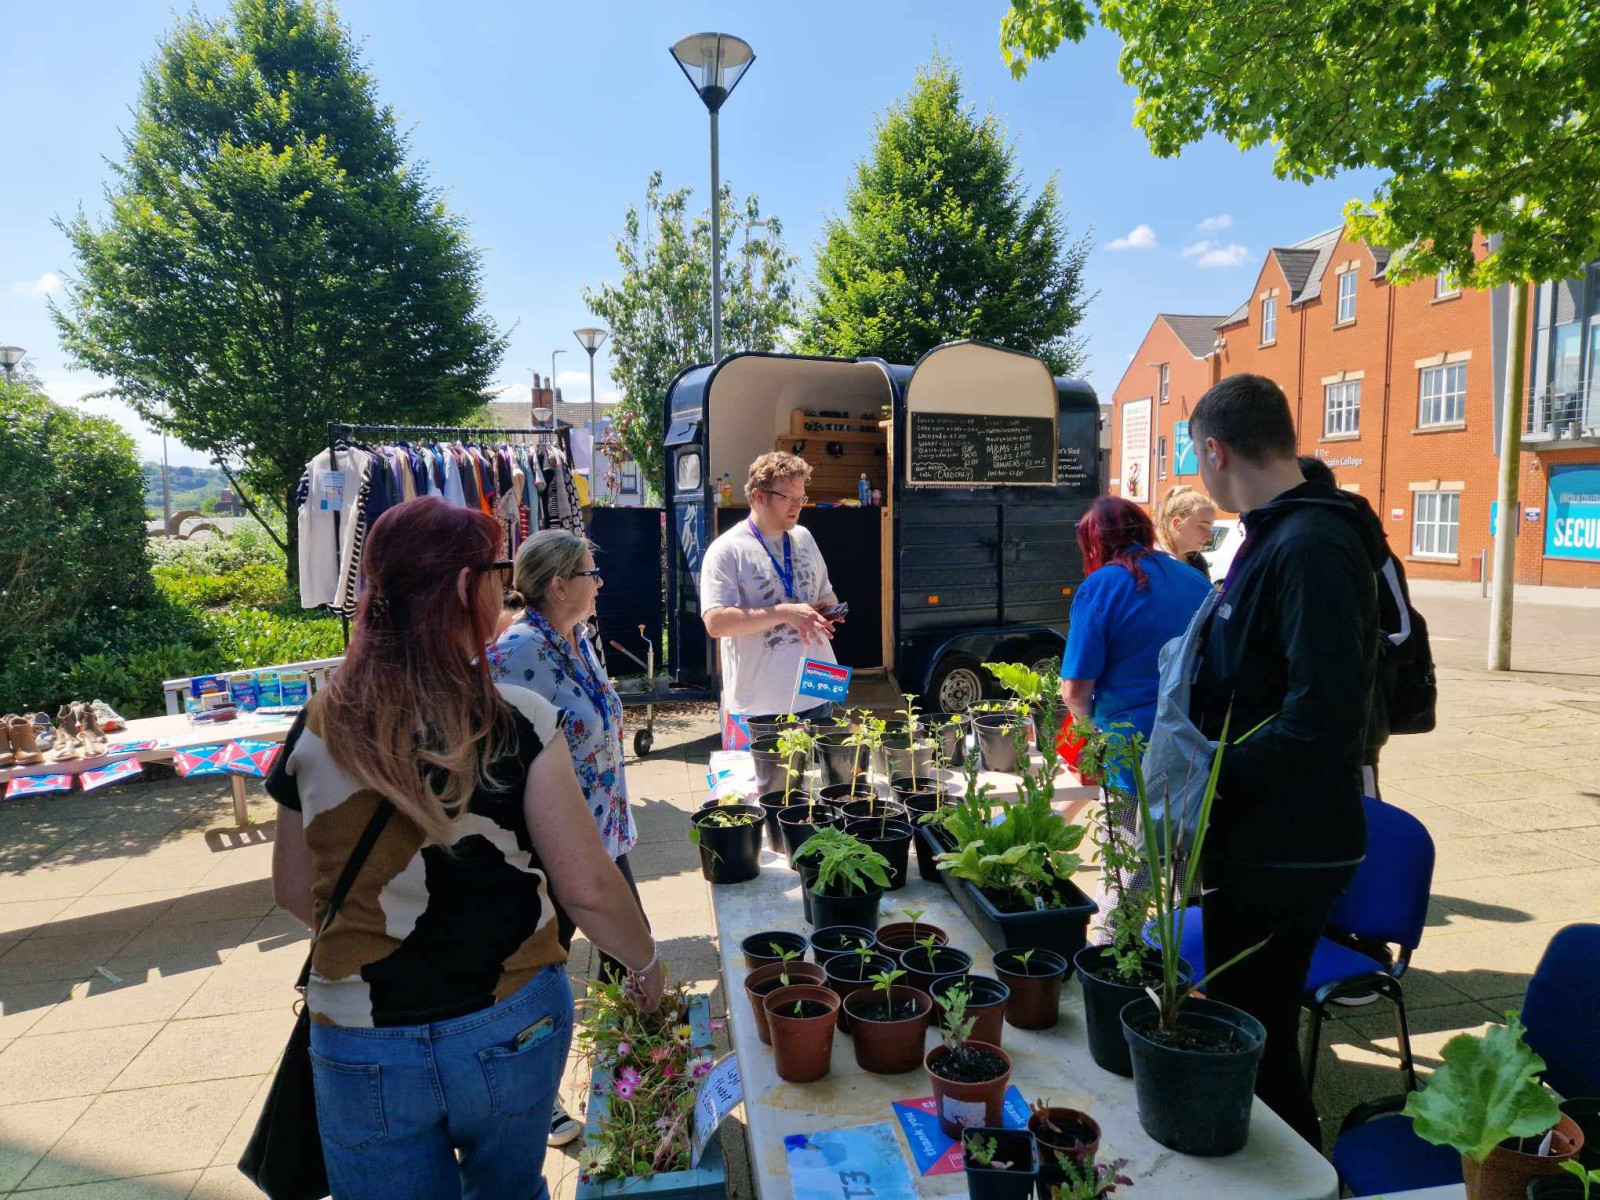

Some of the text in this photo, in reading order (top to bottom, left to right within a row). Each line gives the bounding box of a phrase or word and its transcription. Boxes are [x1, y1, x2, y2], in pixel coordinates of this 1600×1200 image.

[904, 1111, 924, 1130] you
[914, 1128, 938, 1157] thank
[838, 1170, 875, 1200] £1
